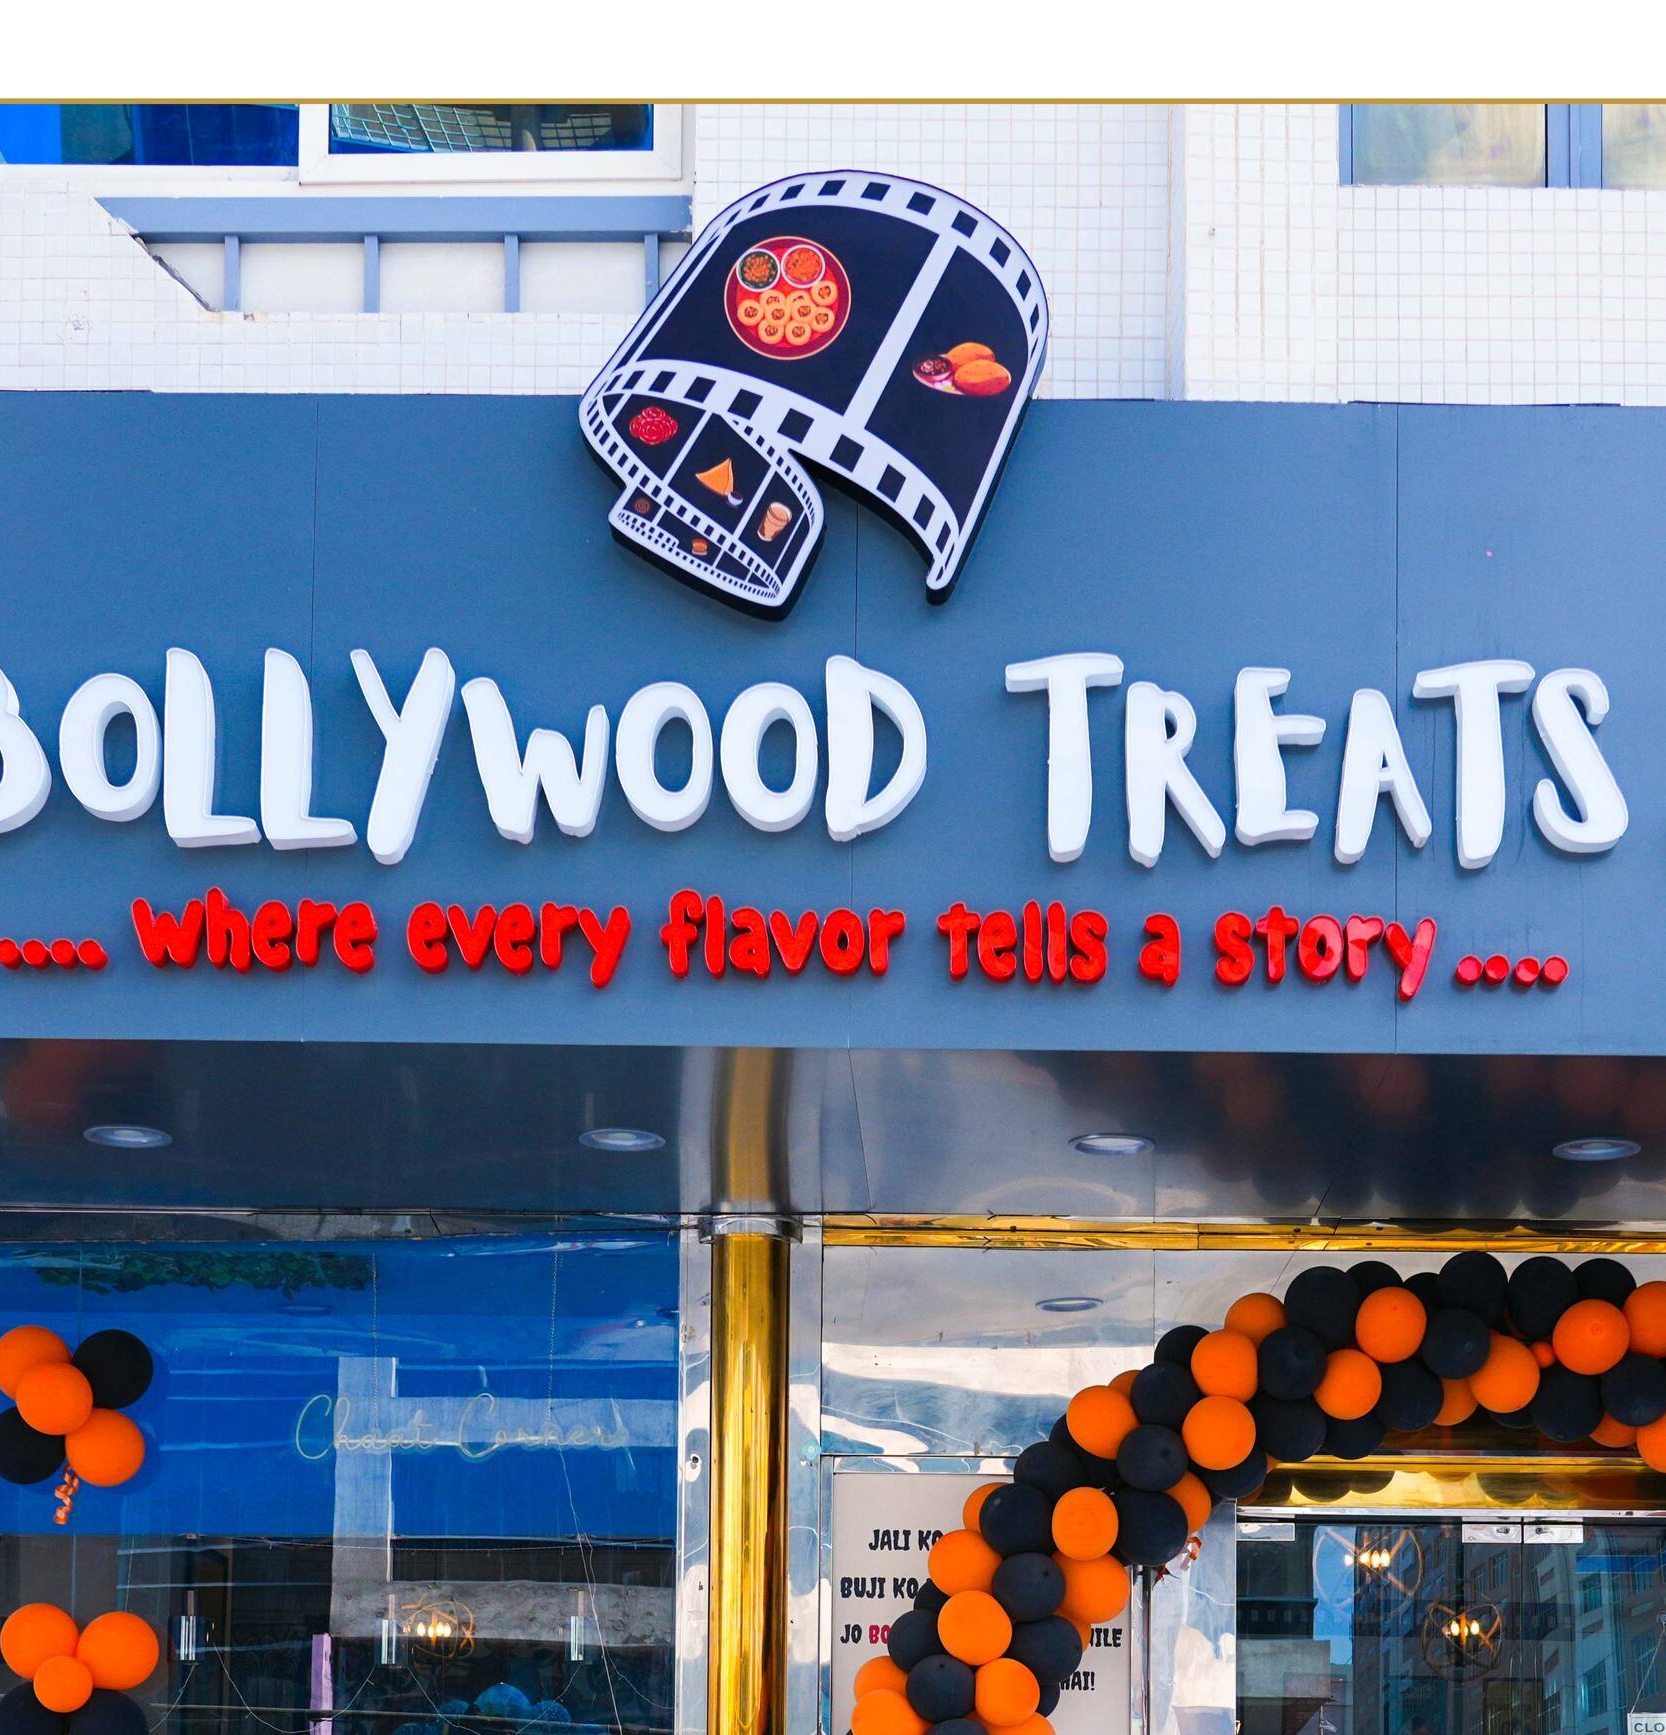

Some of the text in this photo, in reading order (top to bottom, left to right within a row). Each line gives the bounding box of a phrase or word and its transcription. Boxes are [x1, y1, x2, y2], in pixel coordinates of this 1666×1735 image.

[1004, 652, 1629, 868] TREATS
[132, 886, 378, 974] where
[407, 901, 631, 990] every
[660, 888, 907, 981] flavor
[937, 900, 1109, 985] tells
[1139, 913, 1182, 987] a
[1214, 905, 1438, 1002] story
[295, 1393, 437, 1461] Chaat
[868, 1529, 911, 1551] JALI
[840, 1576, 919, 1599] BUJI KO
[840, 1623, 863, 1644] JO
[868, 1624, 891, 1644] BO
